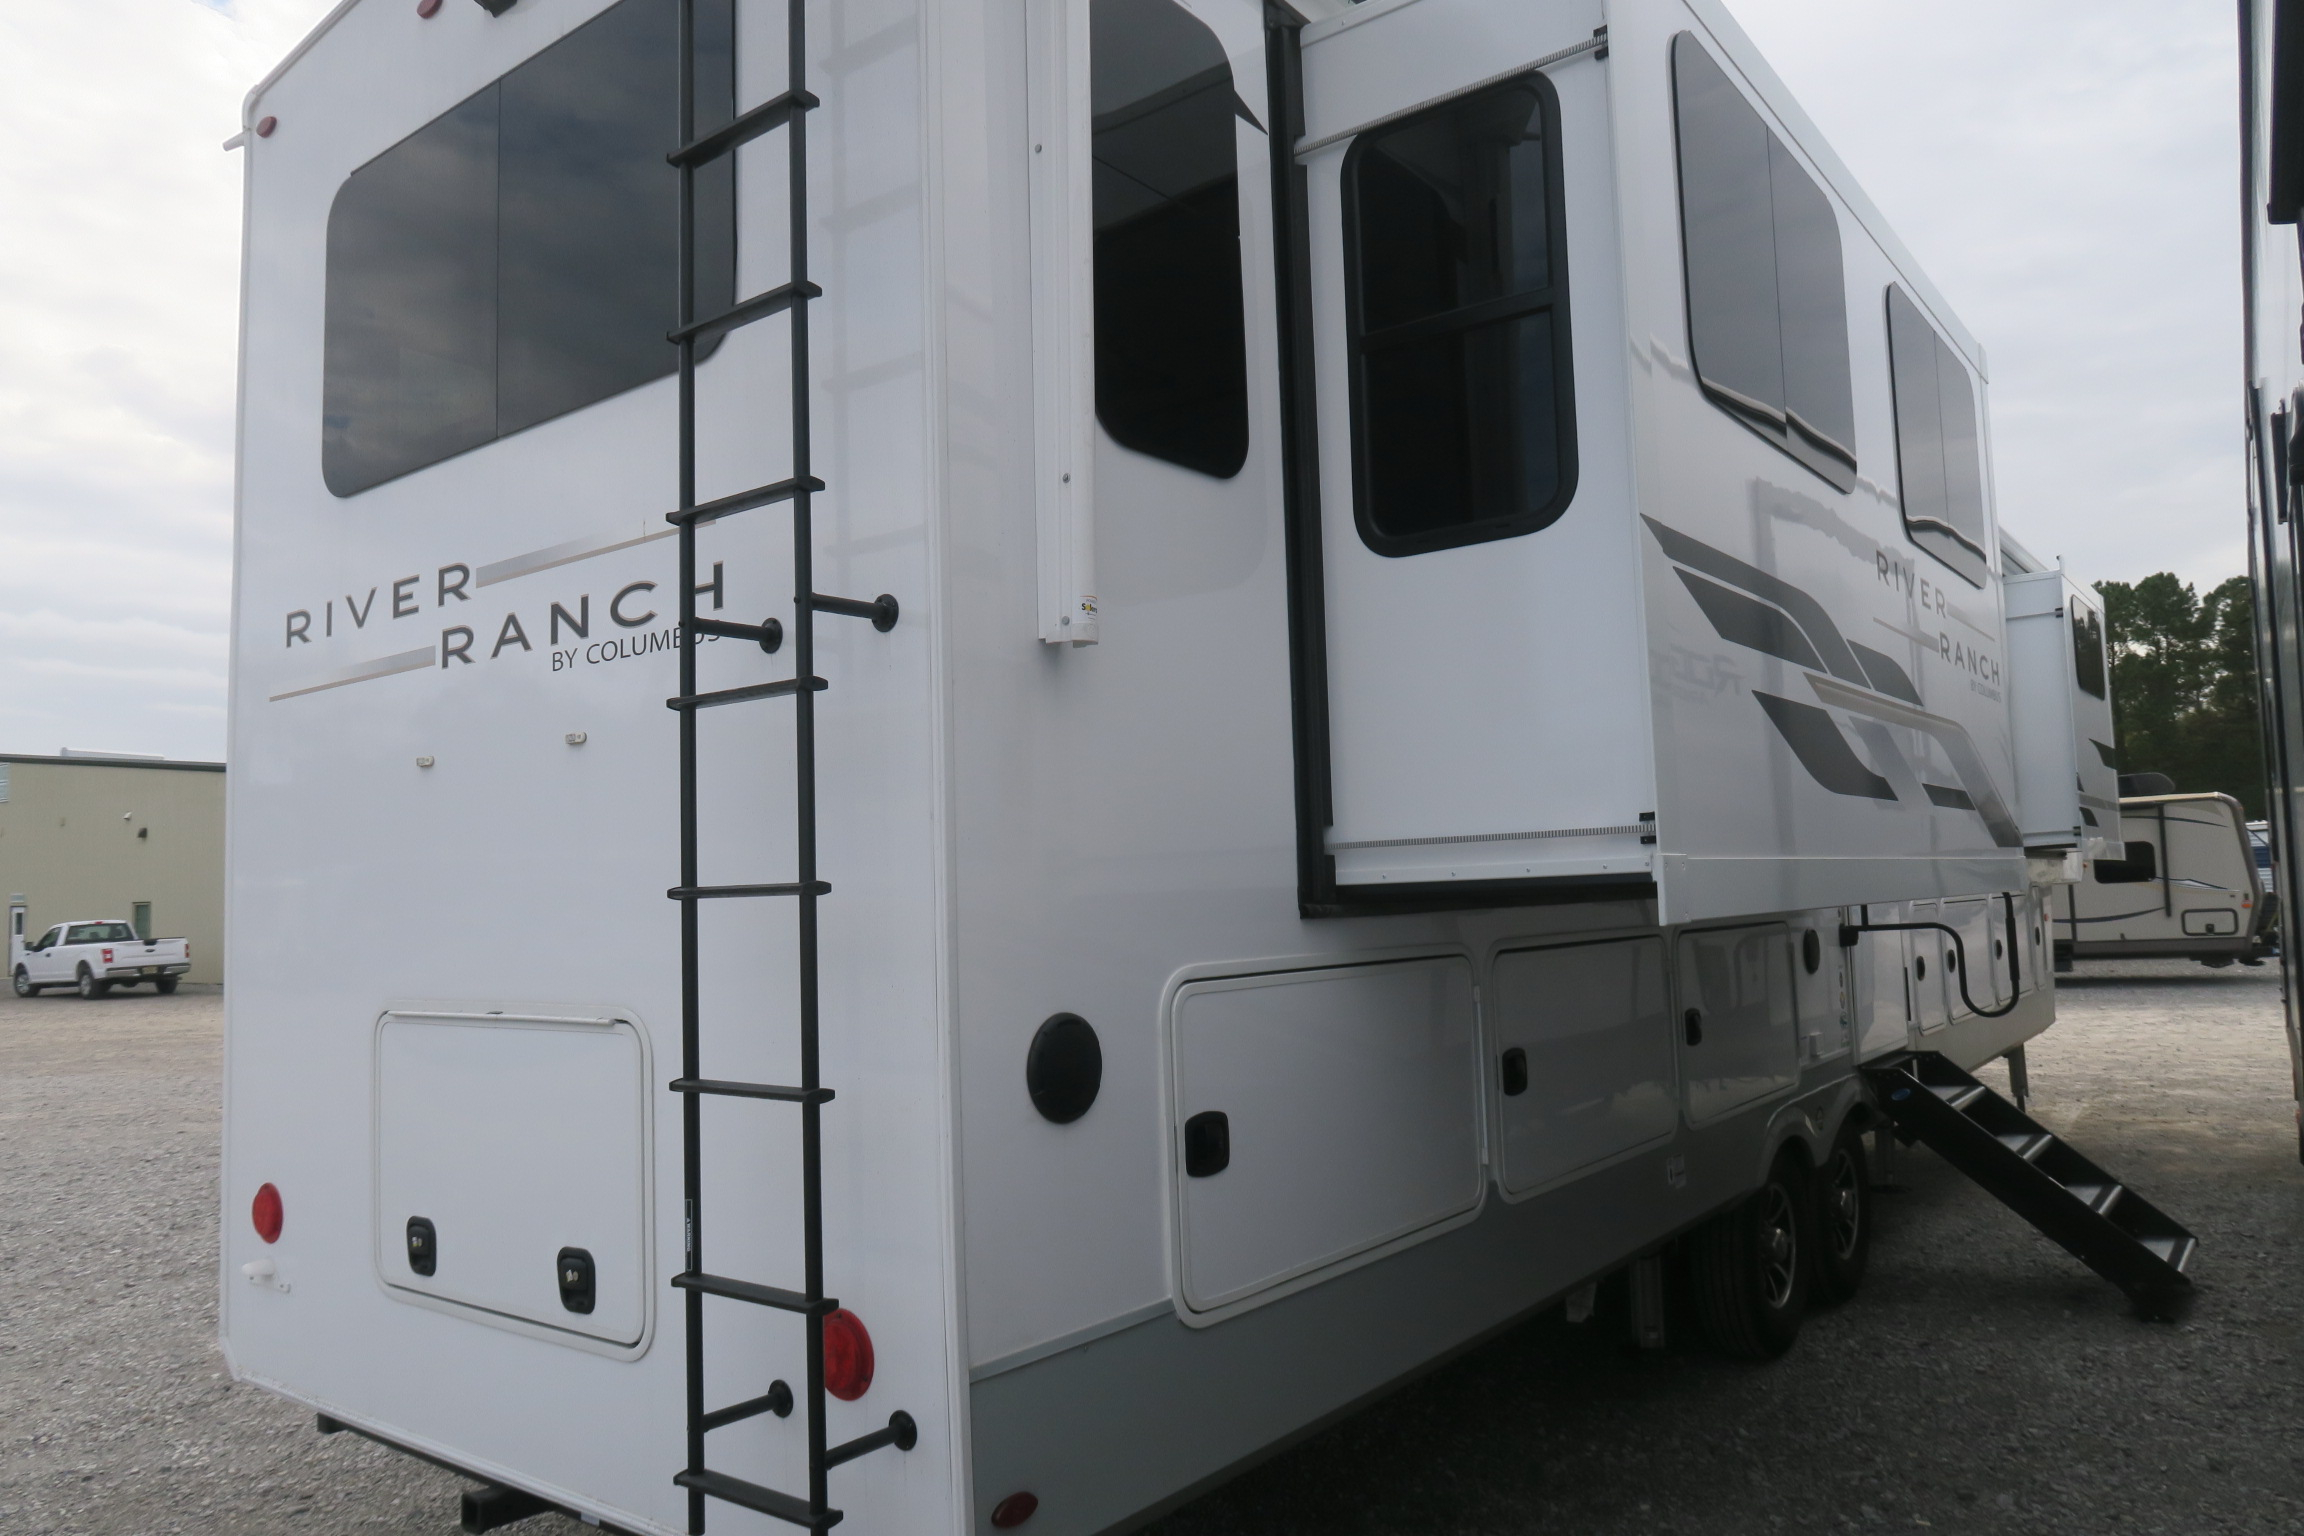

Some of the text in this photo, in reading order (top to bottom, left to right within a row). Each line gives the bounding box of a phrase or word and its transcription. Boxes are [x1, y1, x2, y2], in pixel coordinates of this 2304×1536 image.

[285, 562, 472, 648] RIVER
[441, 560, 725, 669] RANCH
[1875, 549, 1947, 619] RIVER
[551, 648, 578, 672] BY
[1938, 631, 2001, 687] RANCH
